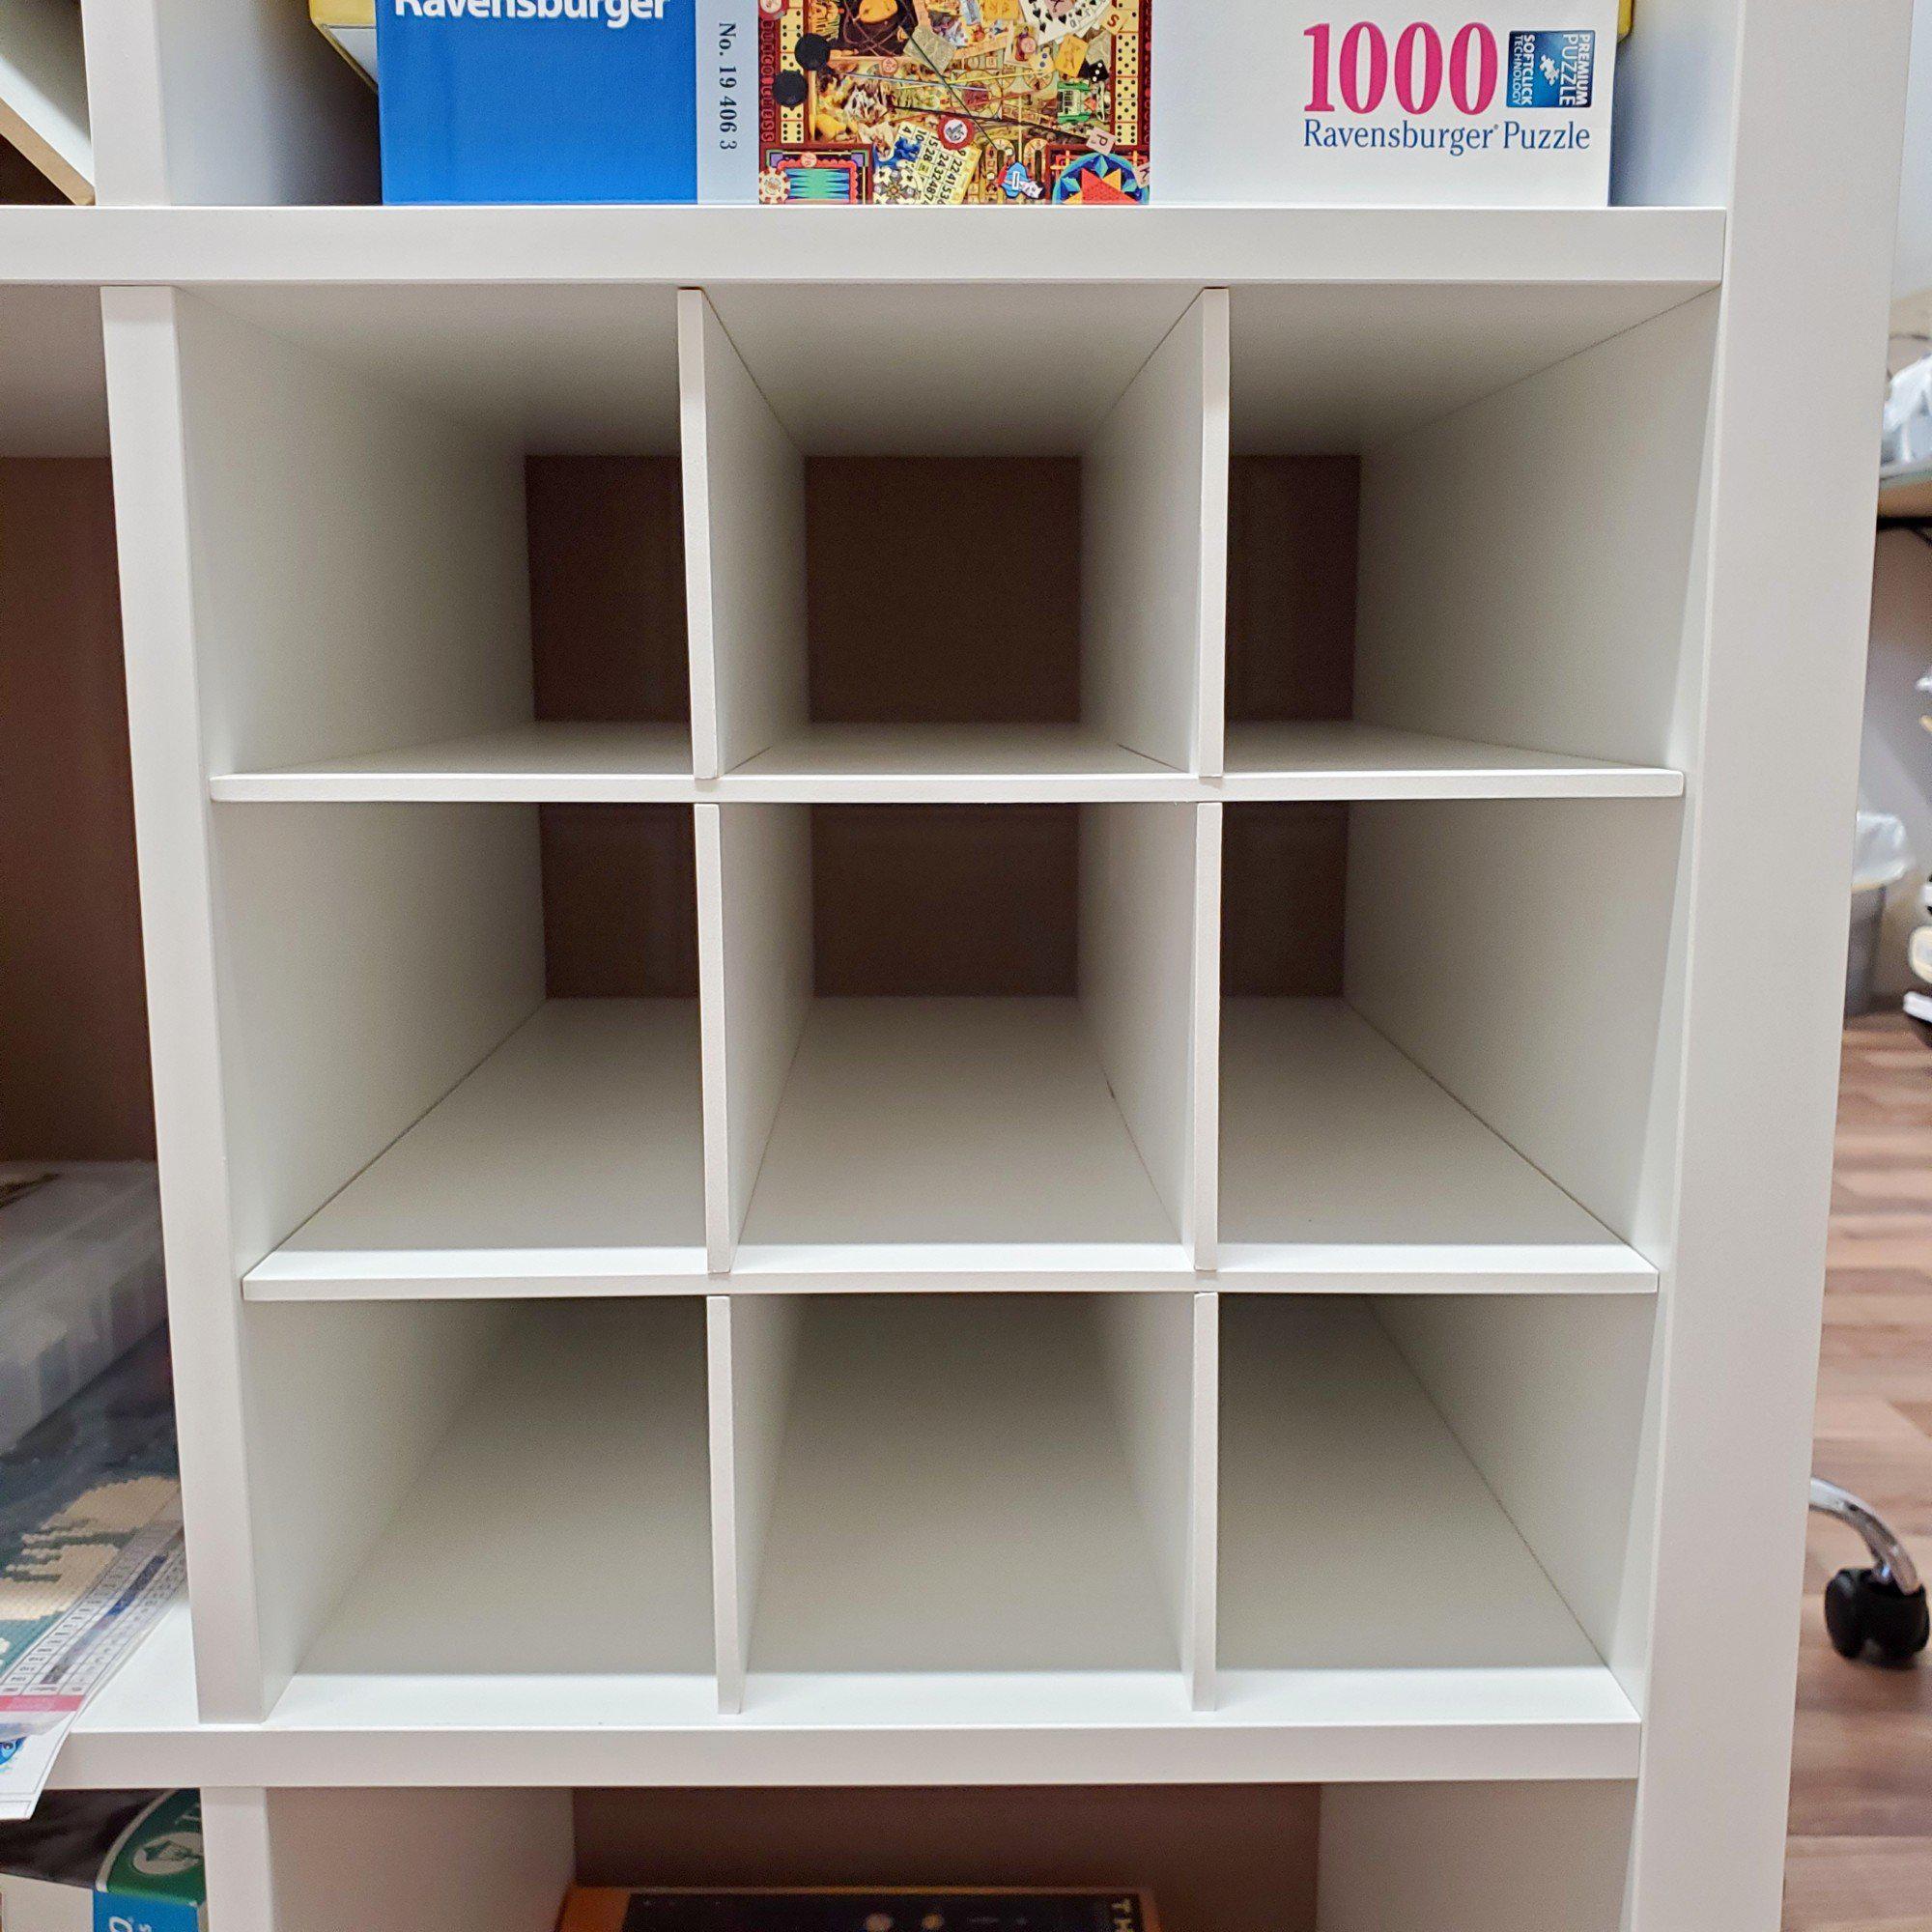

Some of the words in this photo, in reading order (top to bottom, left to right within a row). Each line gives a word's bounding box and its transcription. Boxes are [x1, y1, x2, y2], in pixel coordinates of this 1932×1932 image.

[1107, 14, 1120, 27] S
[719, 22, 737, 56] No.
[719, 65, 737, 88] 19
[1304, 20, 1498, 116] 1000
[1512, 35, 1523, 105] TECHNOLOGY
[1520, 34, 1536, 105] SOFTCLICK
[1558, 34, 1579, 106] PUZZLE
[1575, 34, 1591, 106] PREMIUM
[719, 96, 737, 133] 406
[761, 86, 775, 141] CHESS
[719, 139, 738, 150] 3
[1503, 121, 1590, 149] Puzzle
[923, 148, 935, 161] 28
[937, 154, 949, 167] 24
[951, 159, 962, 173] 22
[932, 167, 943, 181] 32
[946, 173, 955, 185] 41
[926, 182, 937, 193] 48
[940, 185, 952, 199] 53
